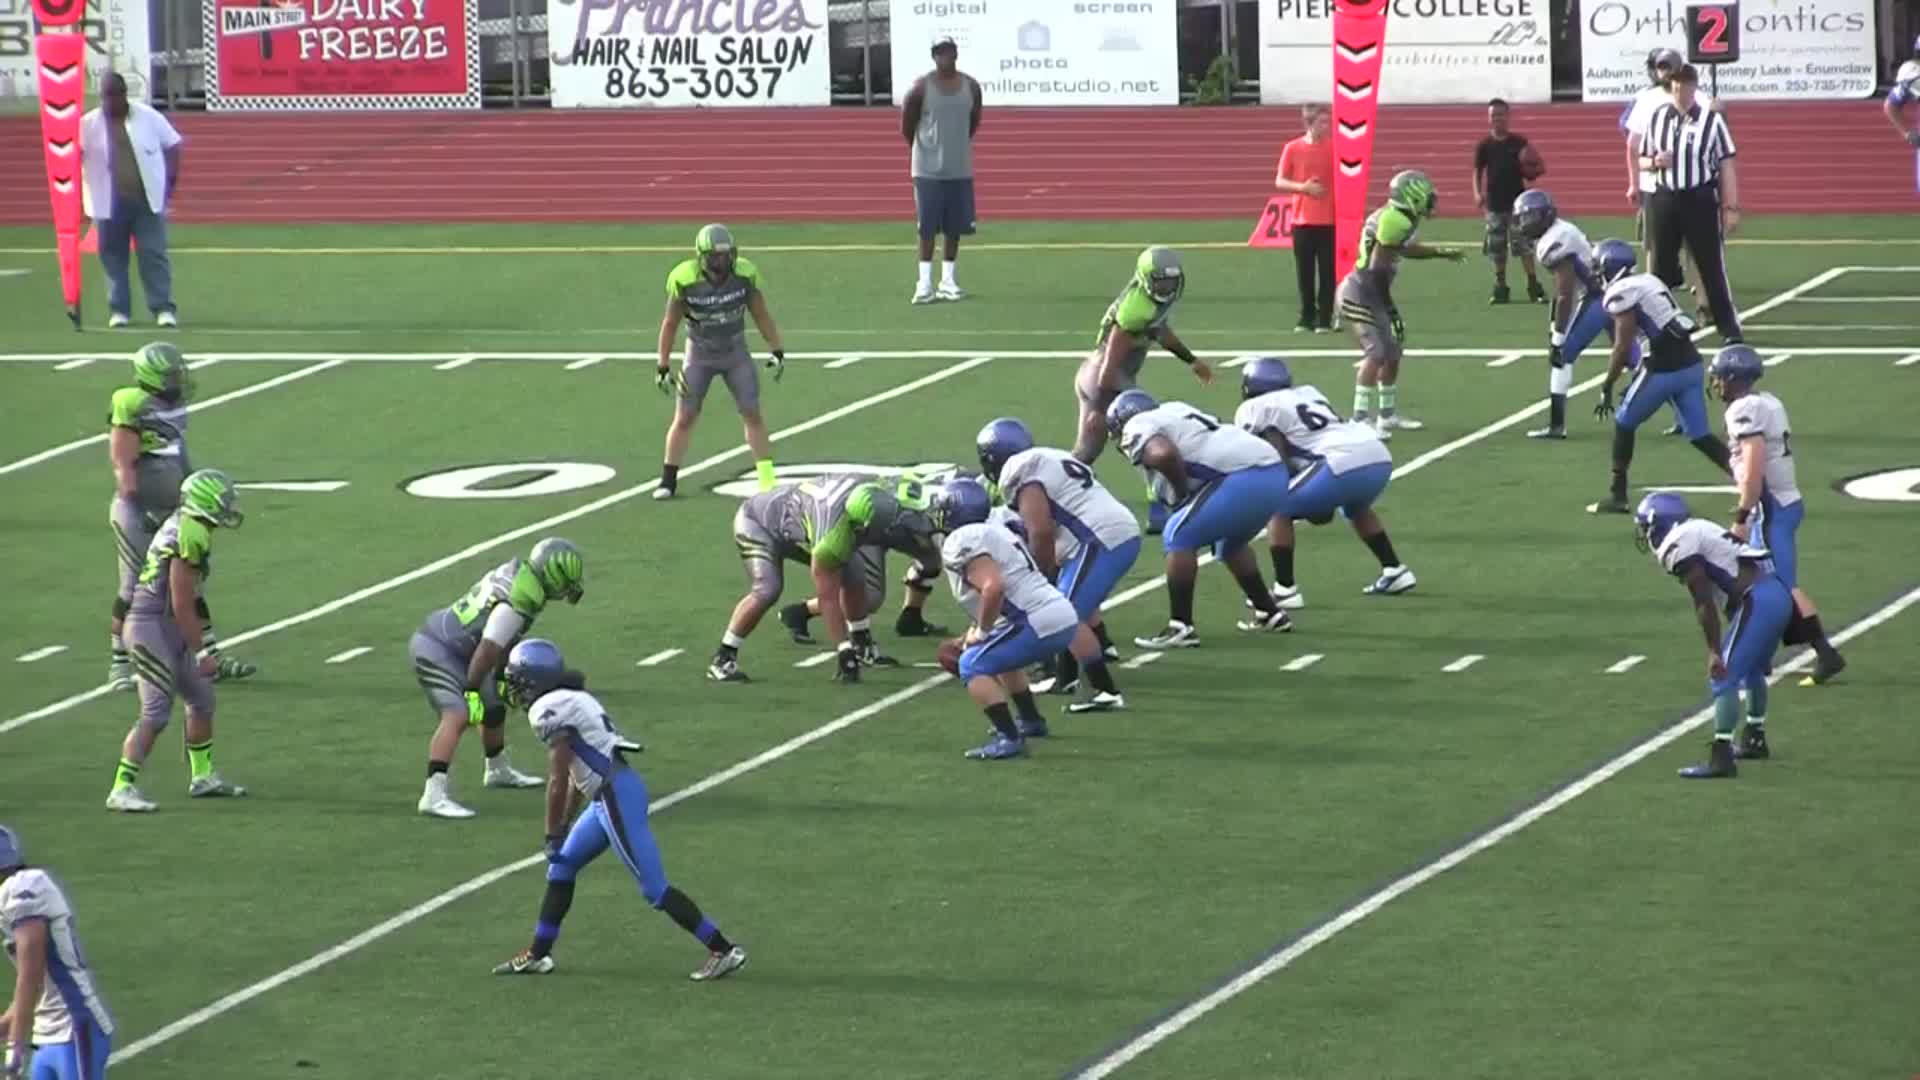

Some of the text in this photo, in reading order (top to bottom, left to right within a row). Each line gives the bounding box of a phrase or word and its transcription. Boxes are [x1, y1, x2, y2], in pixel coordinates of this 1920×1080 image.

[311, 0, 425, 21] DAIRY
[914, 1, 987, 17] digital
[1074, 1, 1152, 14] screen
[1393, 0, 1533, 18] COLLEGE
[224, 10, 271, 31] MAIN
[1696, 6, 1729, 54] 2
[297, 25, 449, 61] FREEZE
[572, 37, 635, 71] HAIR
[650, 38, 706, 65] NAIL
[715, 35, 814, 72] SALON
[999, 55, 1069, 72] photo
[1761, 64, 1792, 76] Lake
[1805, 63, 1873, 75] Enumclaw
[605, 67, 783, 99] 863-3037
